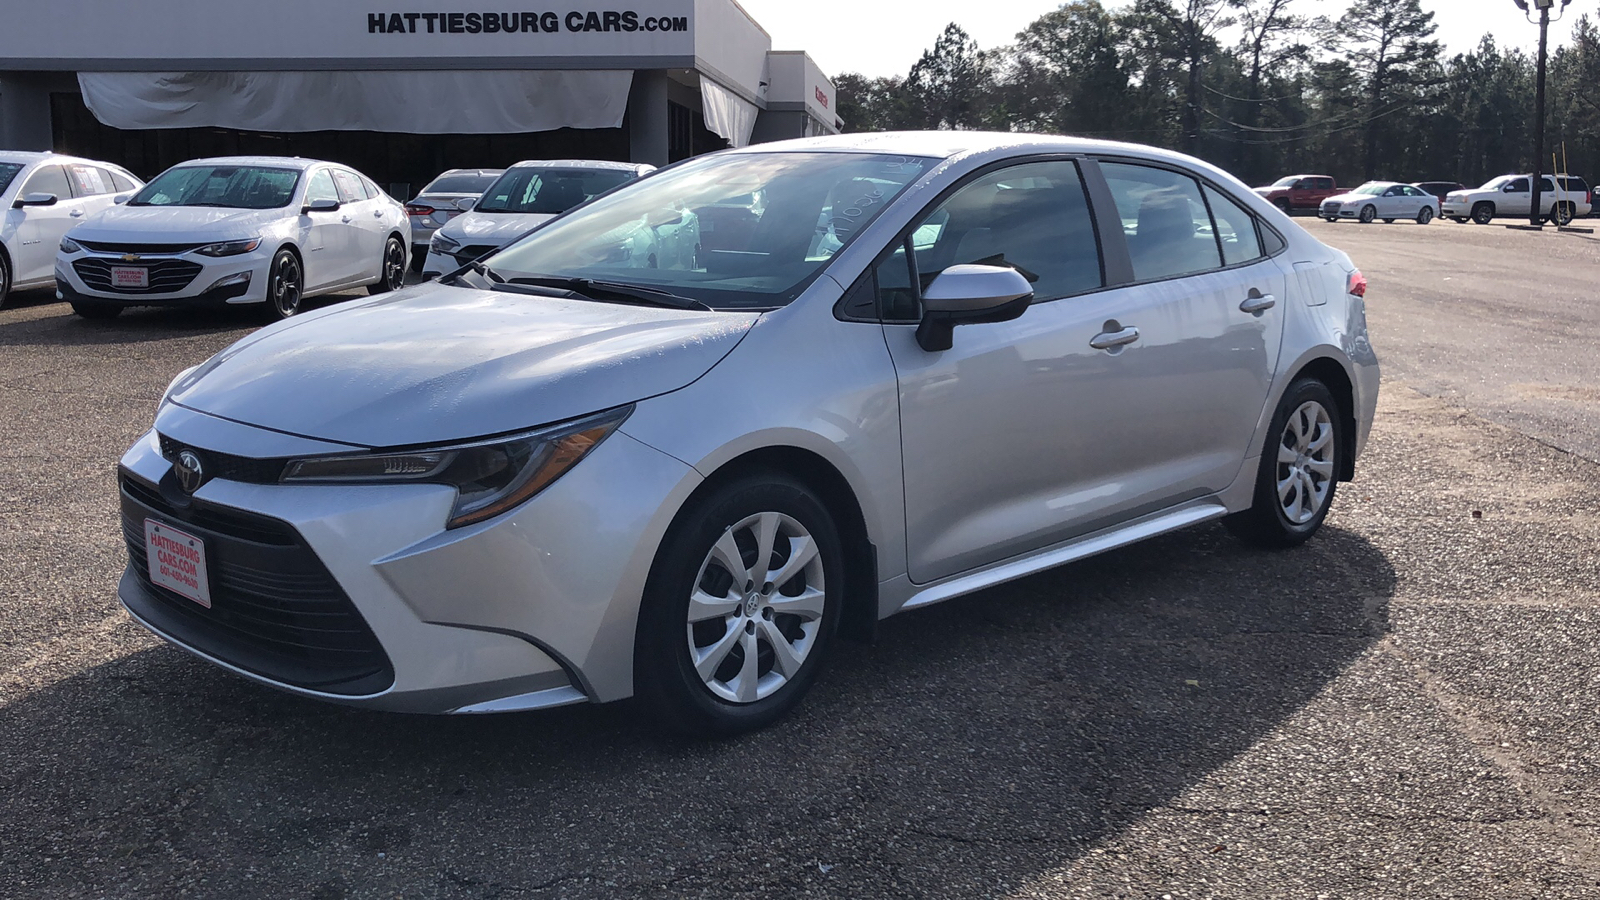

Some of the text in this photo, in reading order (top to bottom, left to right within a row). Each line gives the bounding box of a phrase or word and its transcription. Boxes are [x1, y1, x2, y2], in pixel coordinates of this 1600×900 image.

[367, 12, 559, 33] HATTIESBURG
[150, 532, 200, 564] HATTIESBURG
[157, 549, 198, 577] CARS.COM
